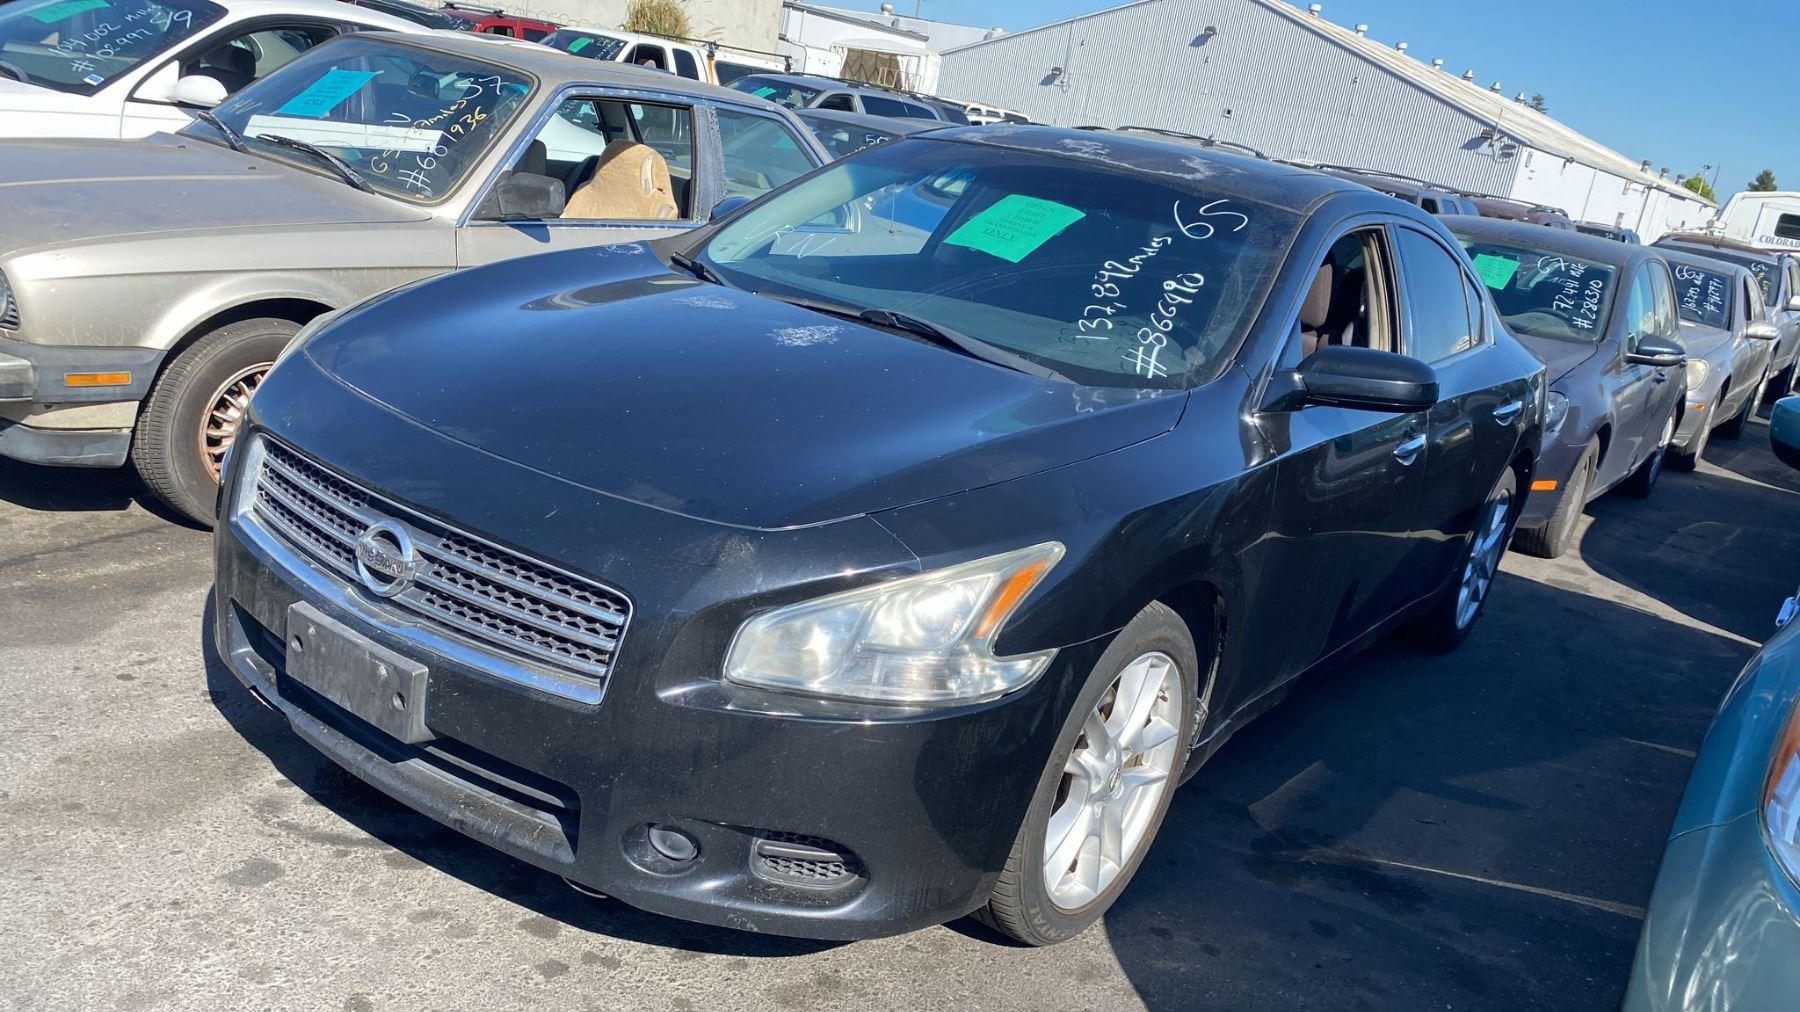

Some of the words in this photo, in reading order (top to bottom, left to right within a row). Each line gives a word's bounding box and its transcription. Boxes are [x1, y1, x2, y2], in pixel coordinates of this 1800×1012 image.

[455, 75, 511, 100] 57
[397, 106, 488, 192] #601936
[1173, 199, 1249, 239] 65
[1537, 255, 1570, 274] 67
[1675, 265, 1697, 280] 66
[1571, 279, 1603, 329] #286310
[1120, 272, 1205, 379] #866490
